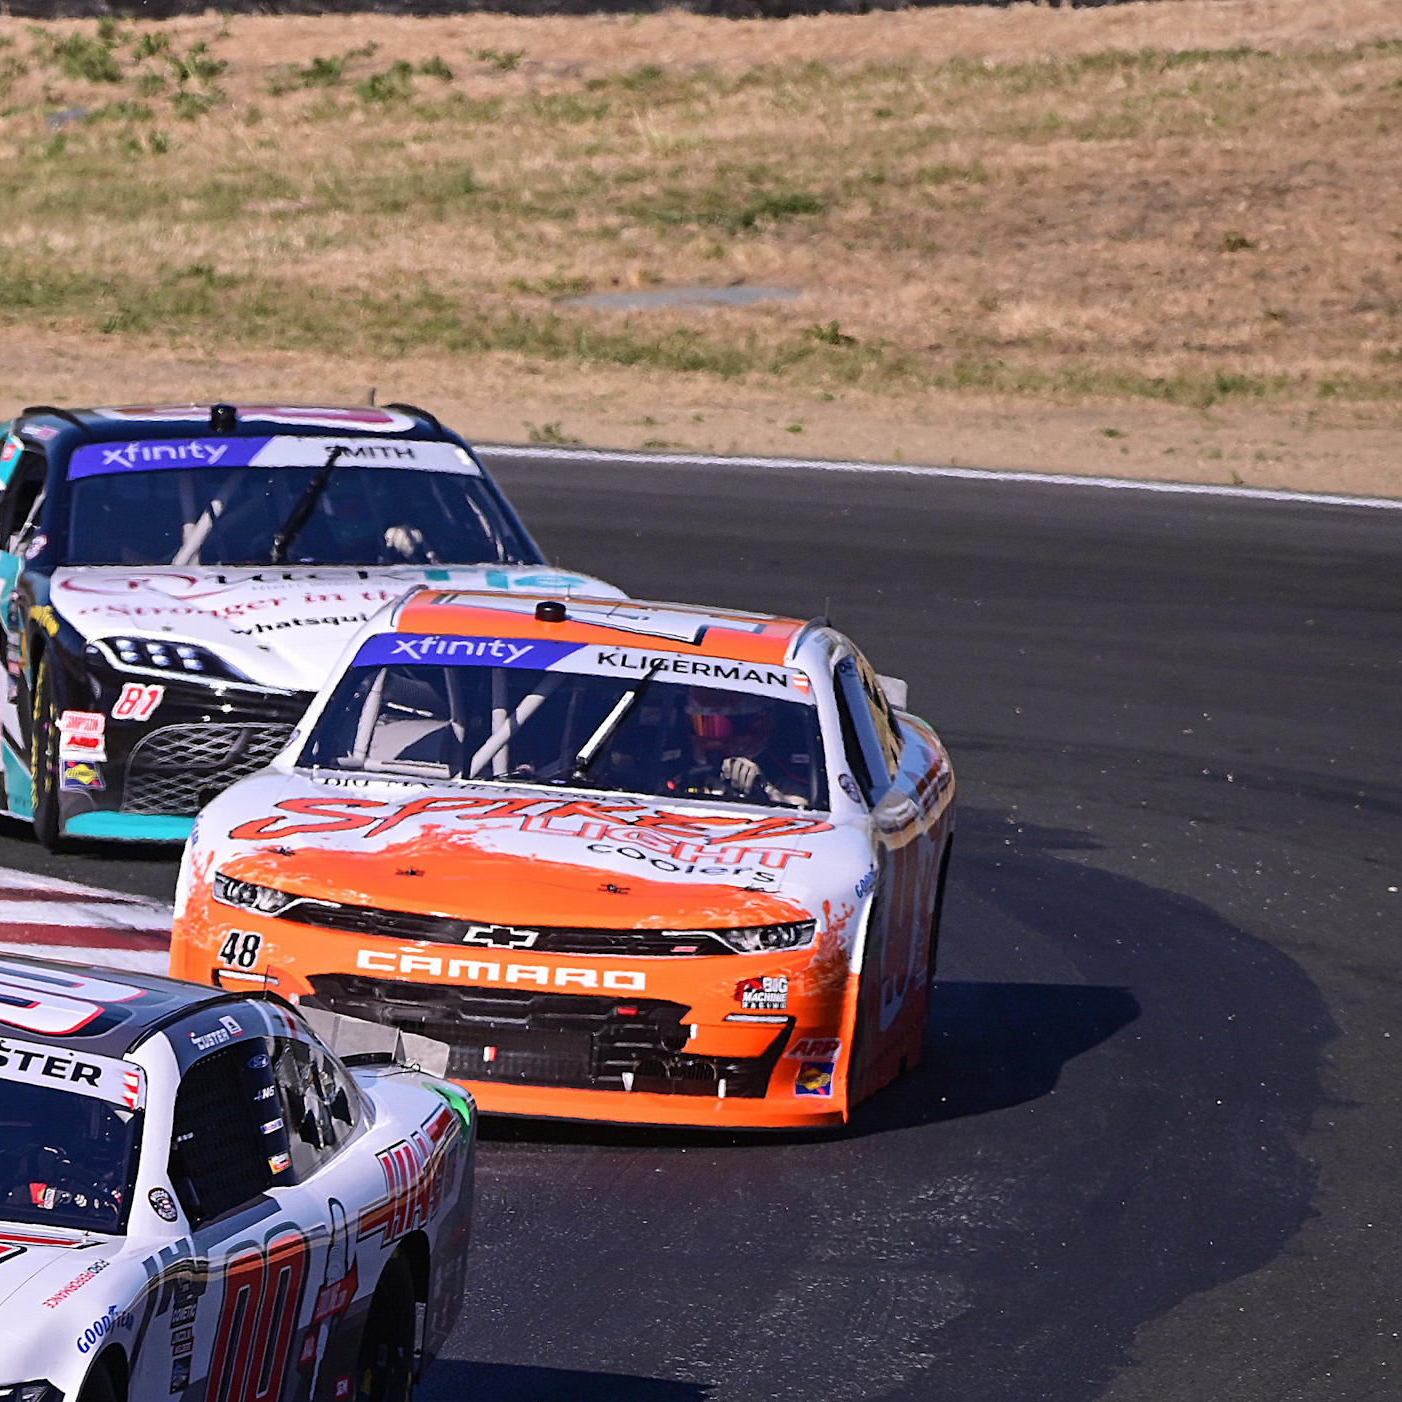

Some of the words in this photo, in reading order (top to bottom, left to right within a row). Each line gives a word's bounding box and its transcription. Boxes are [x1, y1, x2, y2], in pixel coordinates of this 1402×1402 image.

[102, 440, 227, 469] xfinity
[325, 445, 415, 462] SMITH
[391, 636, 534, 664] xfinity
[597, 651, 789, 689] KLIGERMAN
[116, 685, 162, 718] 81
[229, 797, 834, 845] SPIKED
[517, 814, 812, 869] LIGHT
[219, 930, 262, 969] 48
[357, 950, 647, 991] CAMARO
[763, 977, 788, 993] BIG
